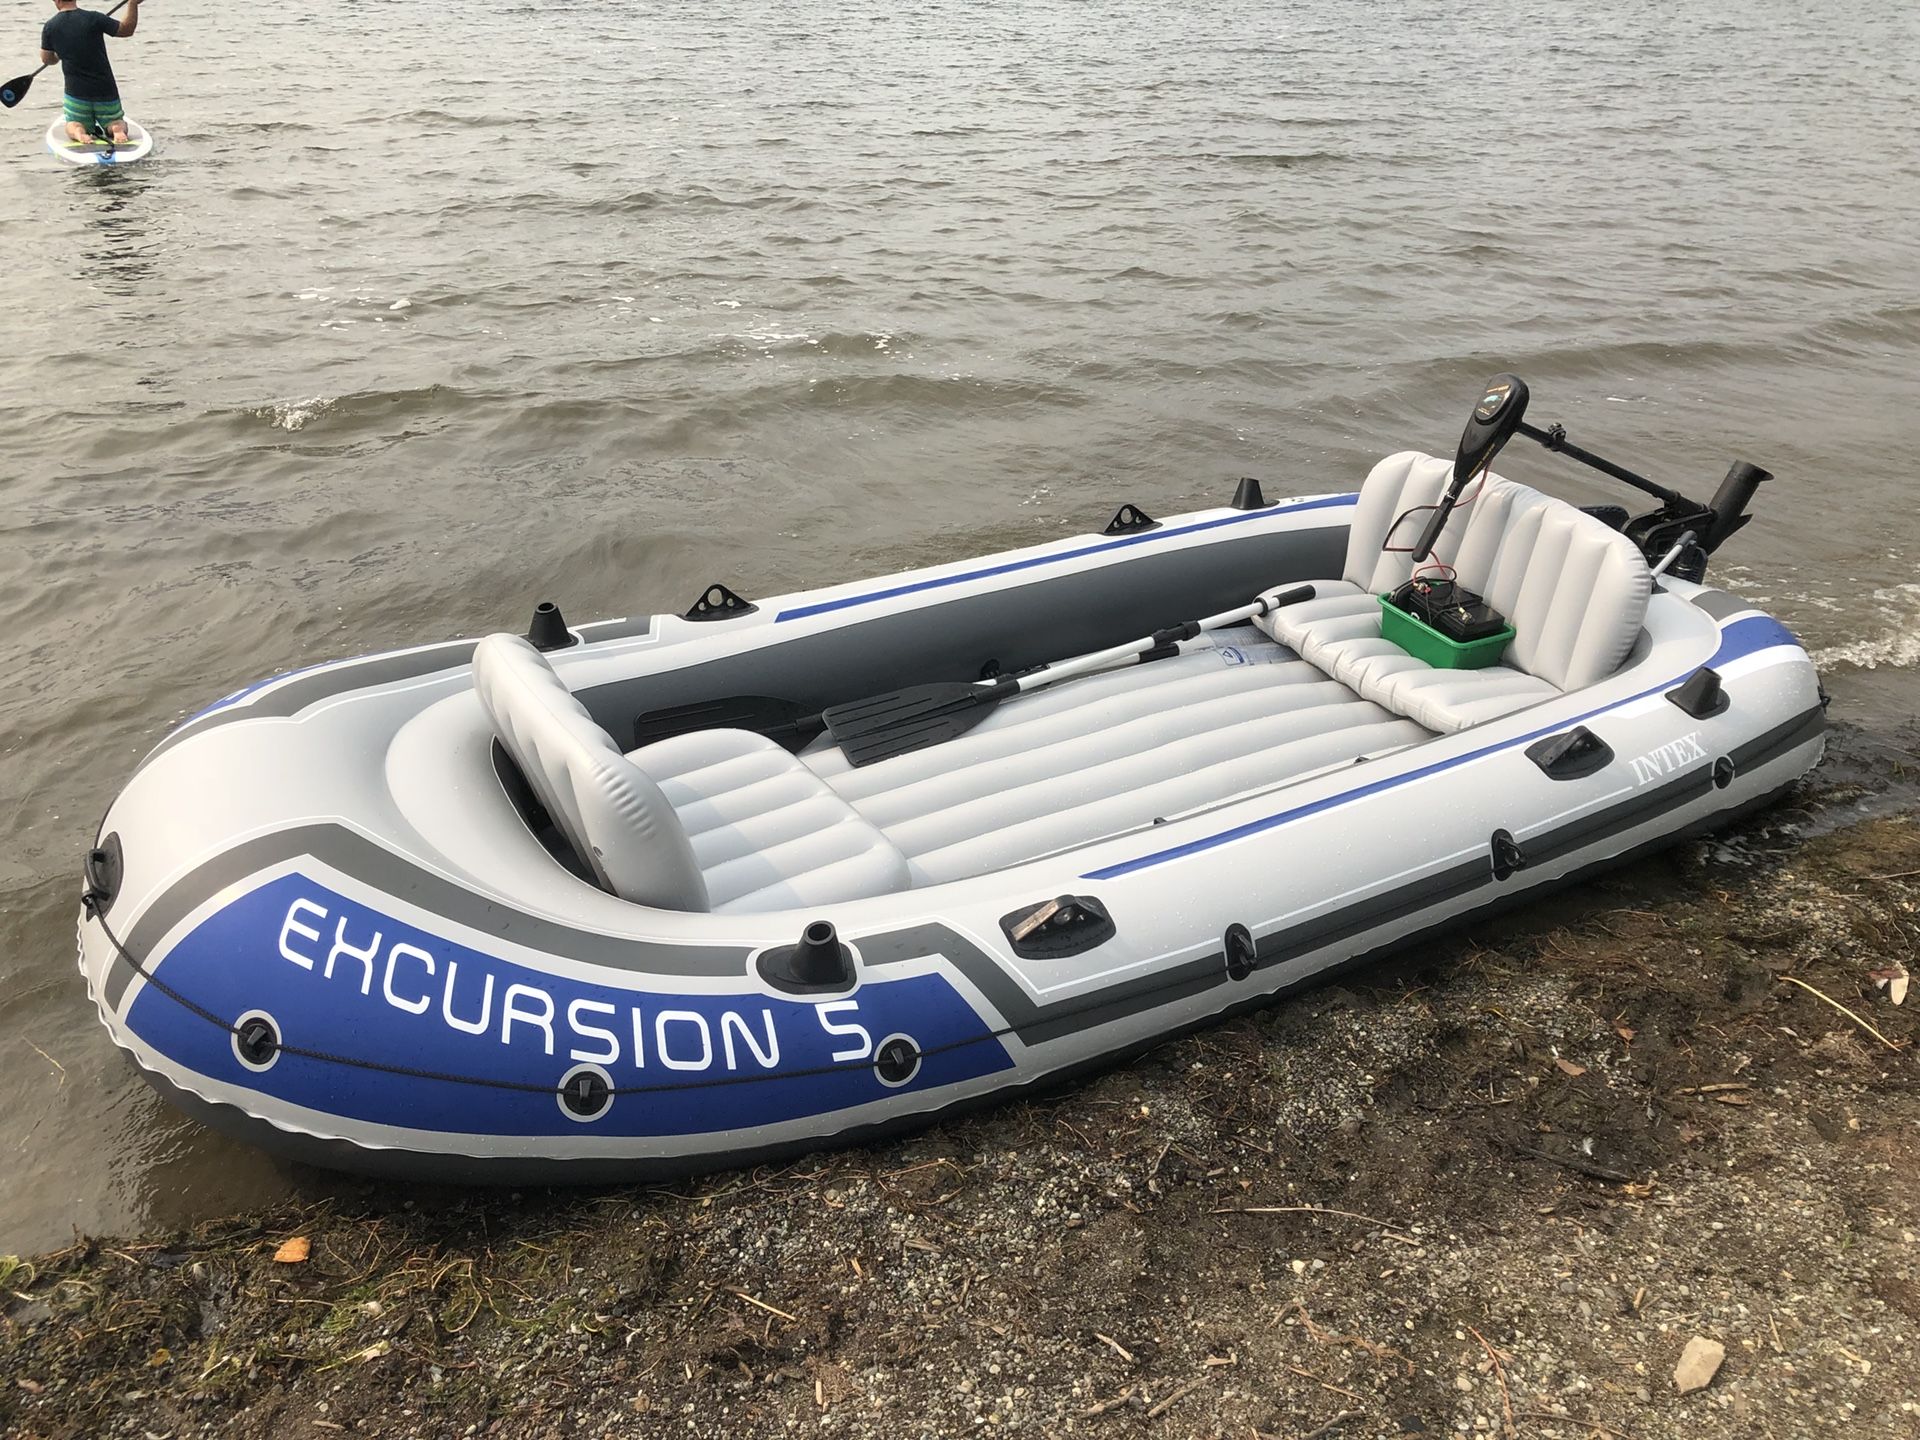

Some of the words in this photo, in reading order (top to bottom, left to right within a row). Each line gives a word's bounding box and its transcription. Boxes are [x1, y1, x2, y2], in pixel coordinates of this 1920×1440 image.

[1630, 733, 1707, 786] INTEX
[278, 898, 780, 1071] EXCURSION
[815, 1001, 873, 1062] 5
